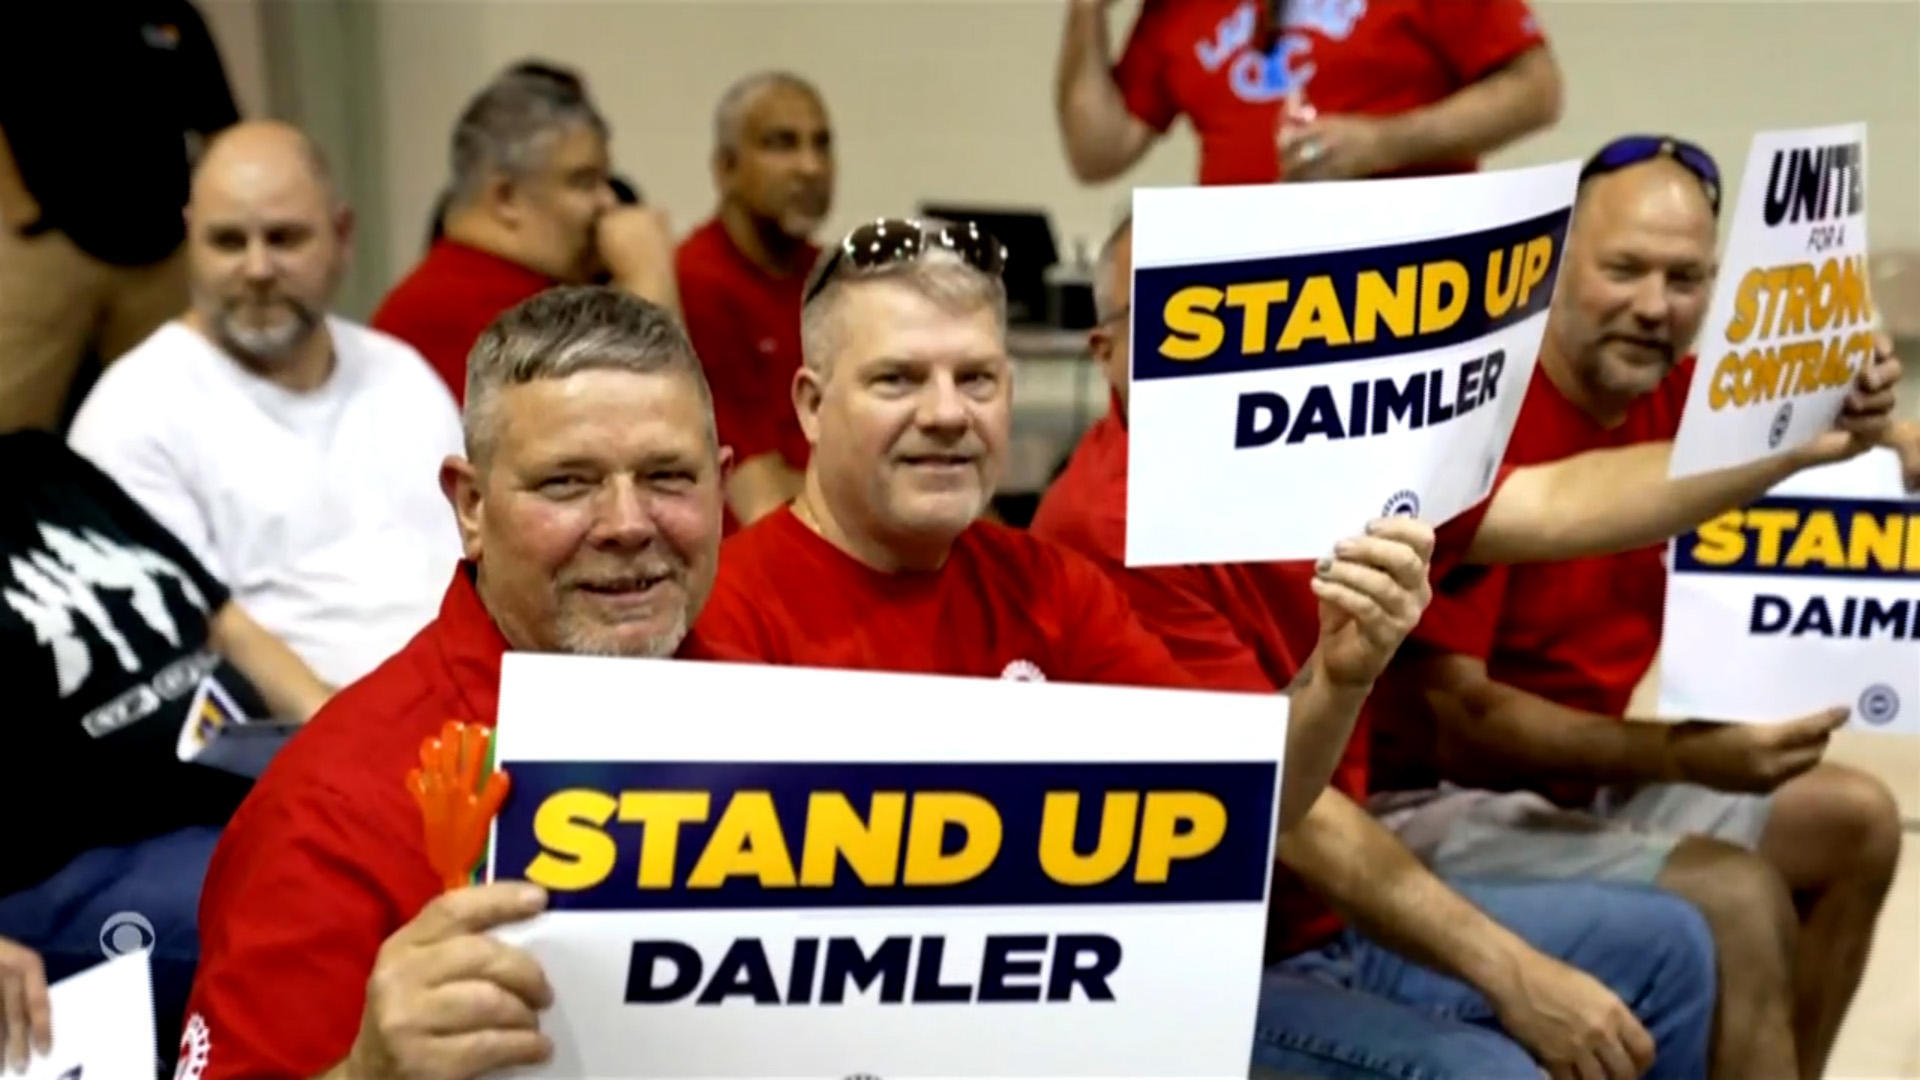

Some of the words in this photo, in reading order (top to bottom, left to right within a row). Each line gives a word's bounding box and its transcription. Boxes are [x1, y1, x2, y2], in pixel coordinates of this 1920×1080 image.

[1158, 259, 1470, 361] STAND
[1484, 235, 1554, 318] UP
[1725, 257, 1871, 344] STRON
[1234, 349, 1506, 449] DAIMLER
[1692, 508, 1920, 571] STAN
[525, 789, 1003, 891] STAND
[1038, 791, 1228, 886] UP
[623, 934, 1123, 1005] DAIMLER
